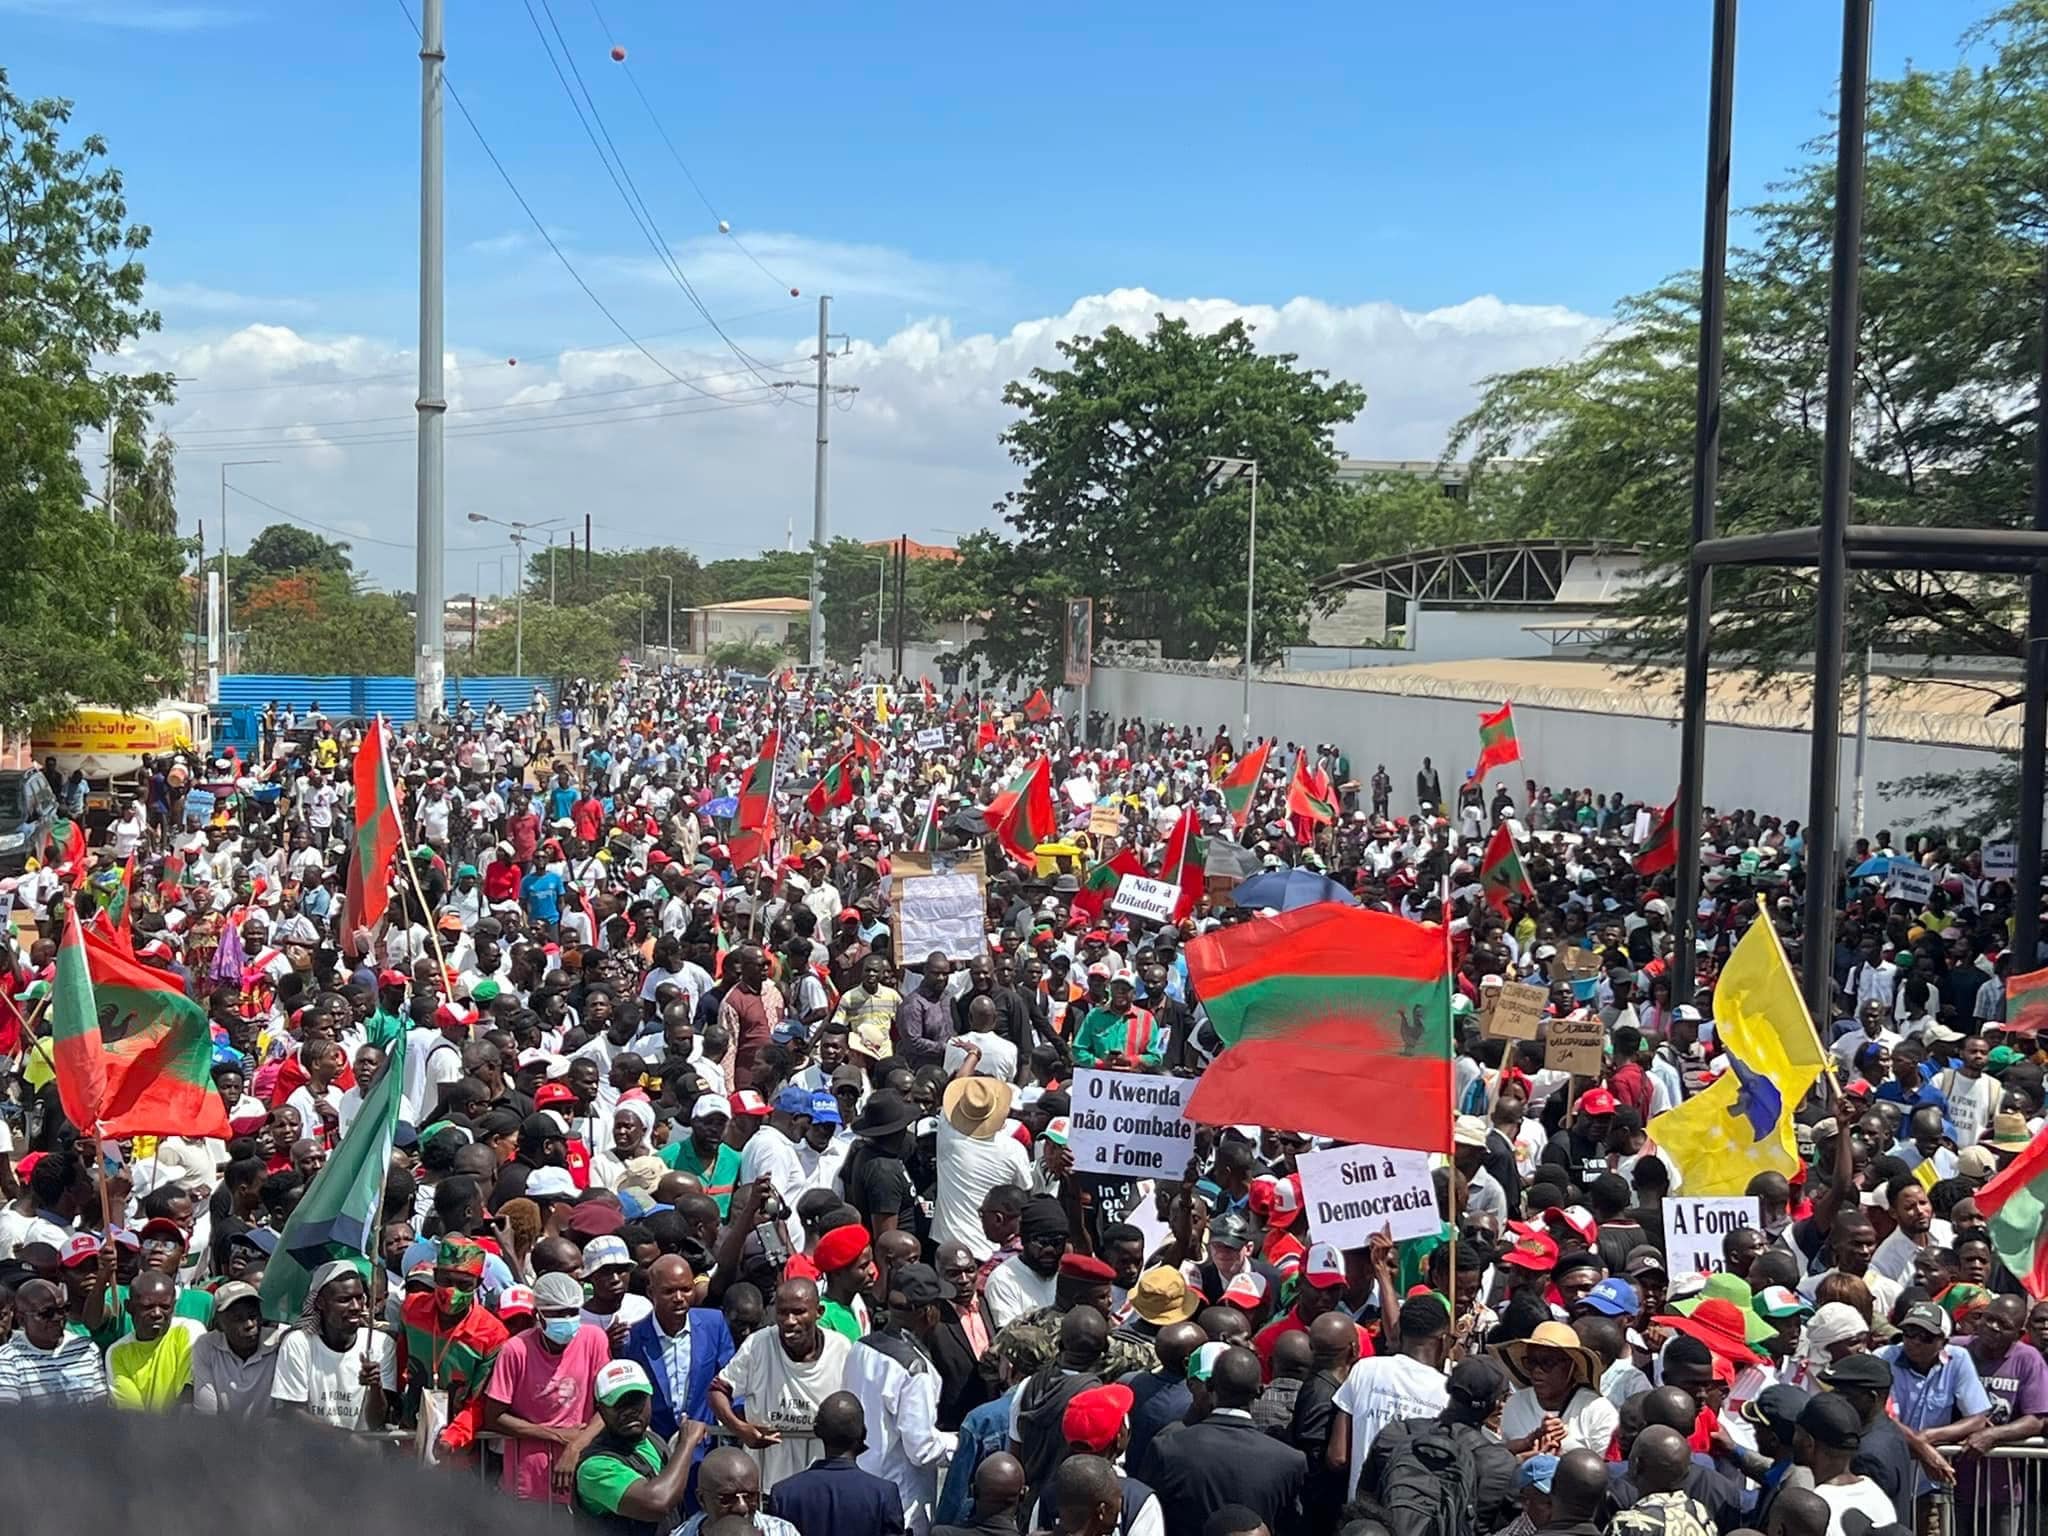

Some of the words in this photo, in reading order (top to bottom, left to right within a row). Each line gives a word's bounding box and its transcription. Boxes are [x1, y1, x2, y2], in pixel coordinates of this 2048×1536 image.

[1133, 879, 1157, 894] Não
[1116, 892, 1169, 915] Ditadura
[1089, 1077, 1103, 1099] O
[1108, 1079, 1181, 1107] Kwenda
[1072, 1109, 1107, 1132] não
[1112, 1115, 1192, 1140] combate
[1095, 1146, 1107, 1163] a
[1112, 1143, 1163, 1169] Fome
[1340, 1161, 1378, 1186] Sim
[1382, 1155, 1396, 1179] à
[1318, 1185, 1433, 1224] Democracia
[1673, 1203, 1688, 1235] A
[1693, 1203, 1750, 1235] Fome
[320, 1391, 327, 1401] A
